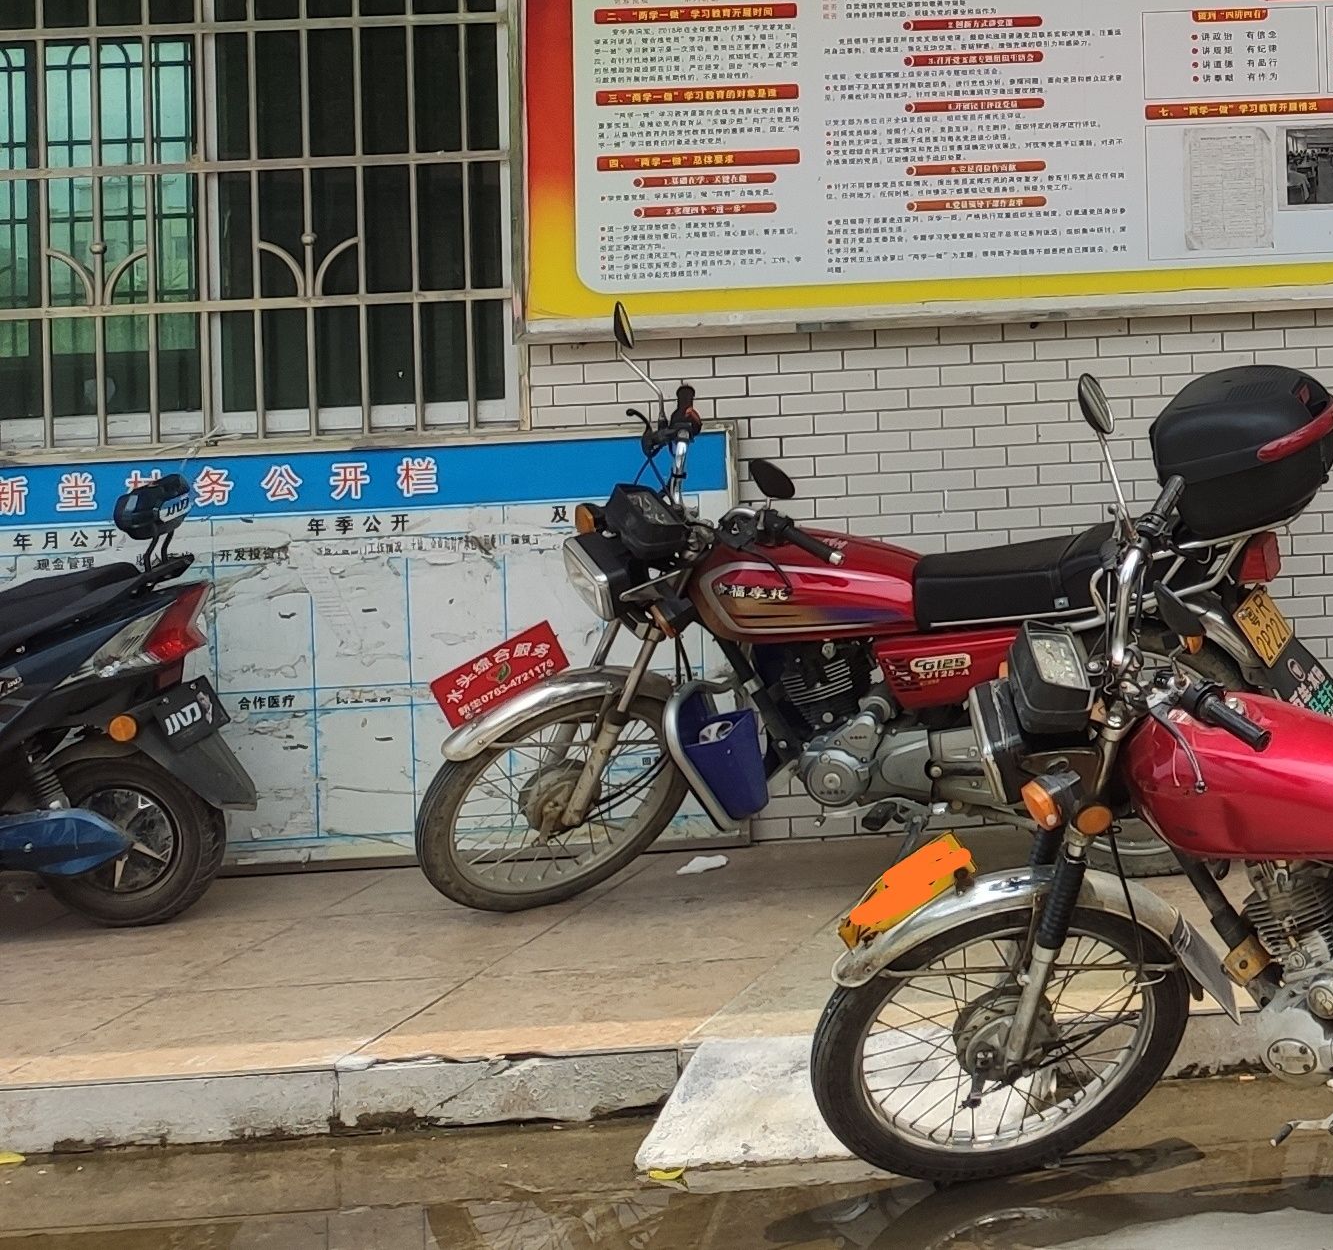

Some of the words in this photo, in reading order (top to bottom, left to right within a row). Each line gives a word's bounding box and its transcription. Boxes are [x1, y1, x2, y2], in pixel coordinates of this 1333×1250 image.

[550, 505, 570, 524] 及
[307, 514, 410, 536] 年季公开
[13, 528, 117, 551] 年月公开
[238, 695, 296, 711] 合作医疗
